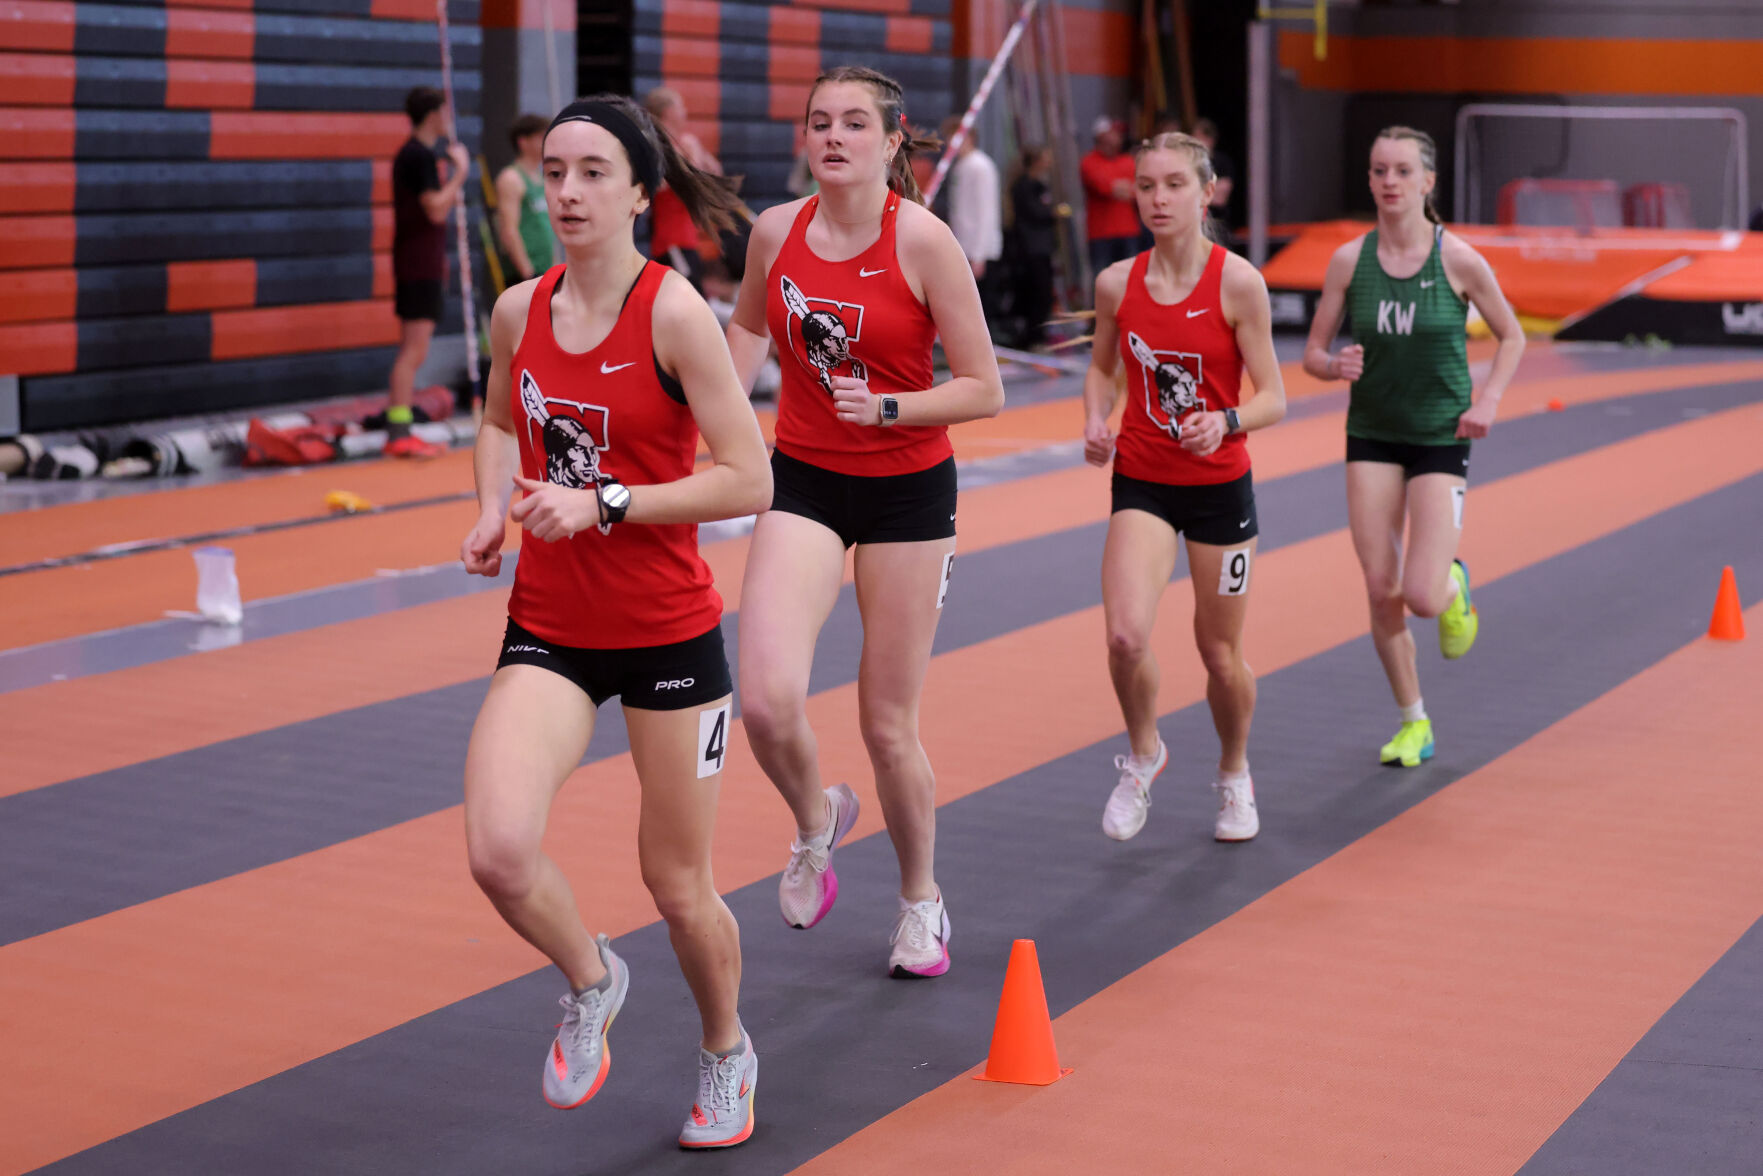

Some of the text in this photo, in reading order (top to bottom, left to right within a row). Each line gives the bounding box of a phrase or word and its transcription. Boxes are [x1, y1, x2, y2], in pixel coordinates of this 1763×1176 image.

[1377, 299, 1417, 336] KW
[1228, 552, 1246, 593] 9
[655, 677, 695, 691] PRO
[705, 709, 726, 770] 4
